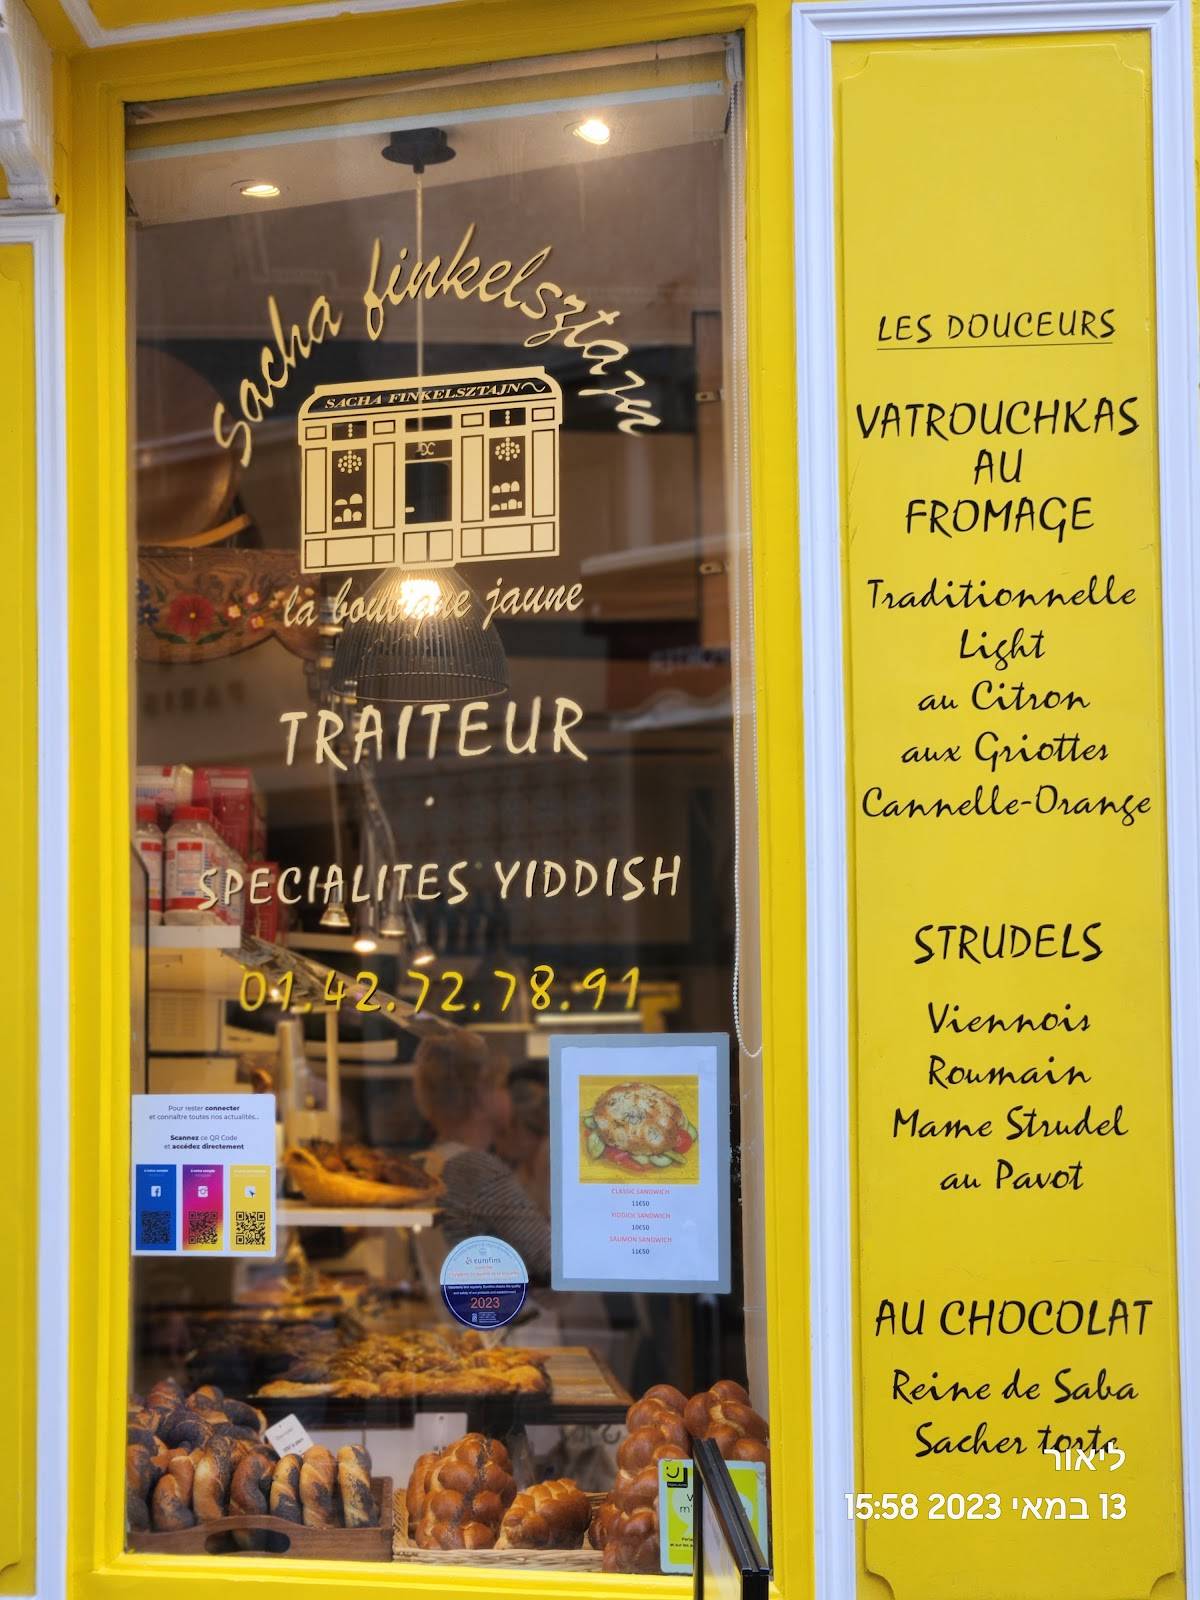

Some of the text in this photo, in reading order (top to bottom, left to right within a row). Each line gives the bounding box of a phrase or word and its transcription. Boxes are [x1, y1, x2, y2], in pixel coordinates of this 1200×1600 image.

[878, 308, 1117, 343] LES DOUCEURS
[212, 294, 344, 467] Sacha
[324, 382, 523, 409] SACHA FINKELSZTAJN
[856, 396, 1140, 441] VATROUCHKAS
[974, 449, 1023, 485] AU
[905, 497, 1095, 543] FROMAGE
[283, 577, 586, 638] la bouque jaune
[867, 575, 1137, 609] Traditionnelle
[959, 628, 1046, 671] Light
[918, 680, 1090, 712] au Citron
[279, 696, 588, 771] TRAITEUR
[901, 732, 1109, 772] aux Griottes
[862, 785, 1152, 827] Cannelle-Orange
[197, 860, 470, 910] SPECIALITES
[494, 855, 683, 904] YIDDISH
[913, 922, 1104, 964] STRUDELS
[238, 964, 642, 1015] 01.42.72.78.91
[927, 1002, 1091, 1034] Viennois
[928, 1055, 1092, 1089] Roumain
[893, 1104, 1129, 1141] Mame Strudel
[940, 1159, 1085, 1190] au Pavot
[470, 1297, 500, 1309] 2023
[876, 1298, 1153, 1336] AU CHOCOLAT
[892, 1368, 1139, 1404] Reine de Saba
[915, 1422, 1027, 1457] Sacher
